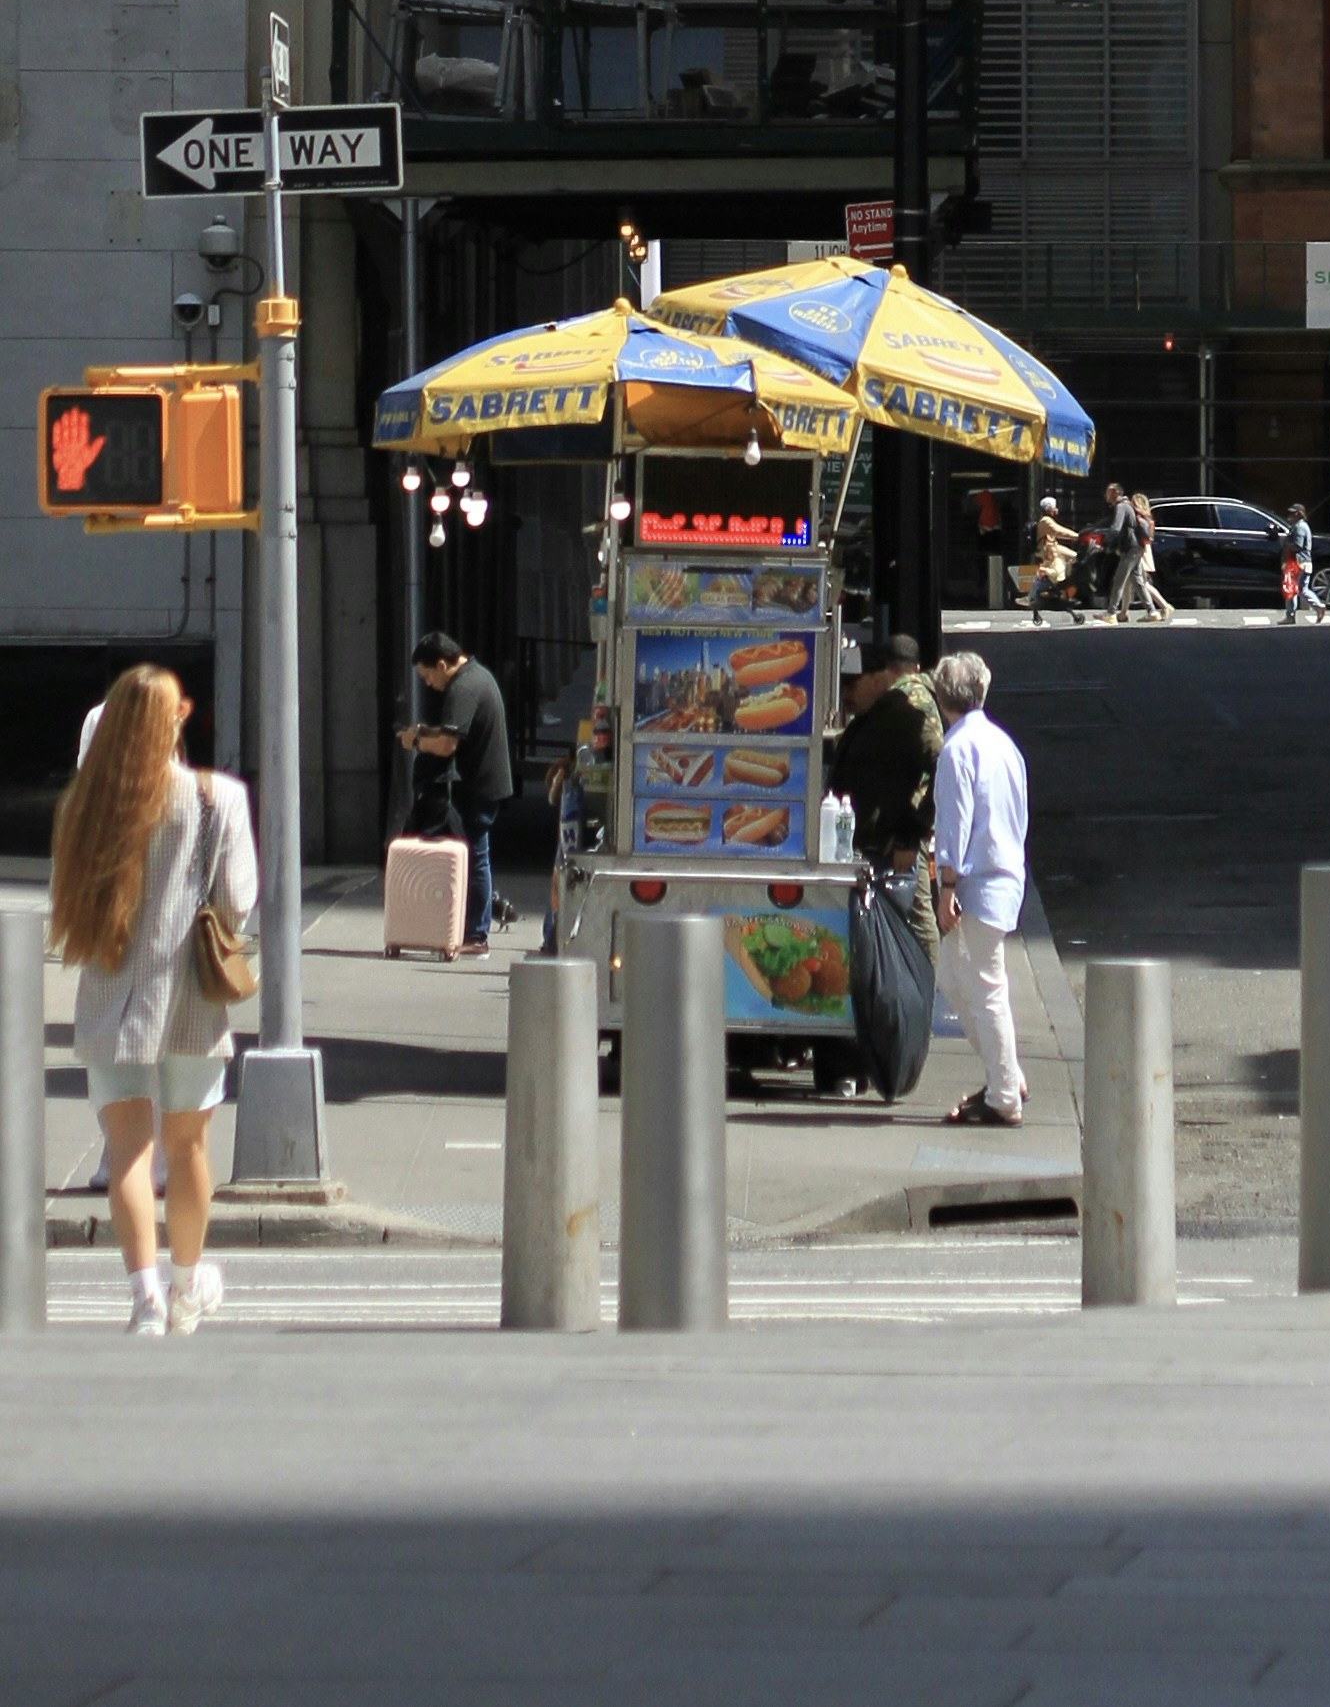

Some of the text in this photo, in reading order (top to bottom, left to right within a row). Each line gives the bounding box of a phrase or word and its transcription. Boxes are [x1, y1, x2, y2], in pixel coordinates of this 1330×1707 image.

[183, 133, 365, 171] ONE WAY
[850, 210, 864, 221] NO
[851, 221, 888, 235] Anytime
[882, 331, 985, 357] SABRETT
[429, 385, 600, 425] SABRETT
[863, 377, 1027, 447] SABRETT
